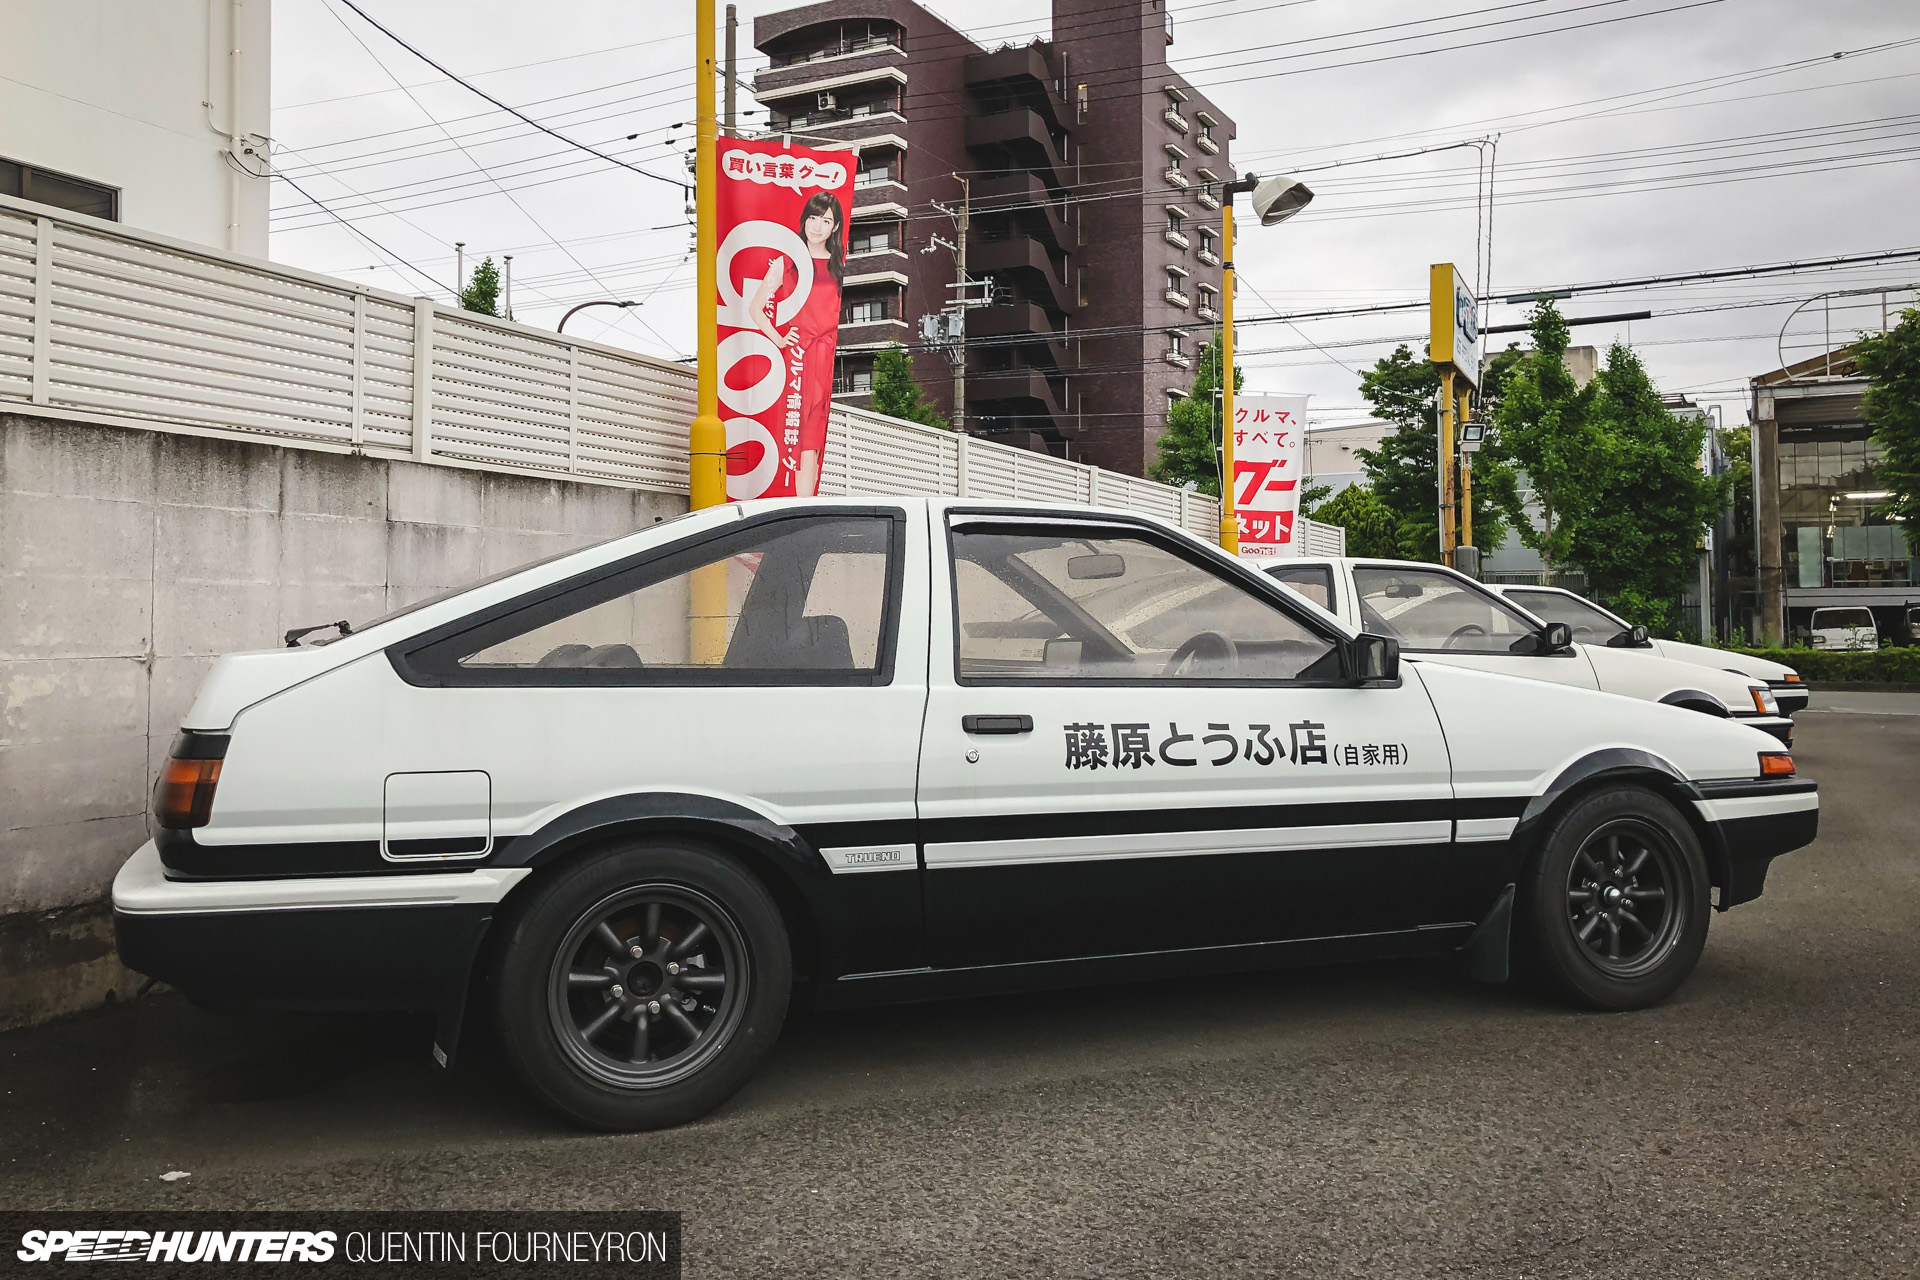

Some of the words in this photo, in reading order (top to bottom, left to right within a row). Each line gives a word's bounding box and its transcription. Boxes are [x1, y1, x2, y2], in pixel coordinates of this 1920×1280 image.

[728, 157, 795, 179] 買い言葉
[1063, 720, 1328, 771] 藤原とうふ店
[845, 851, 901, 864] TRUENO
